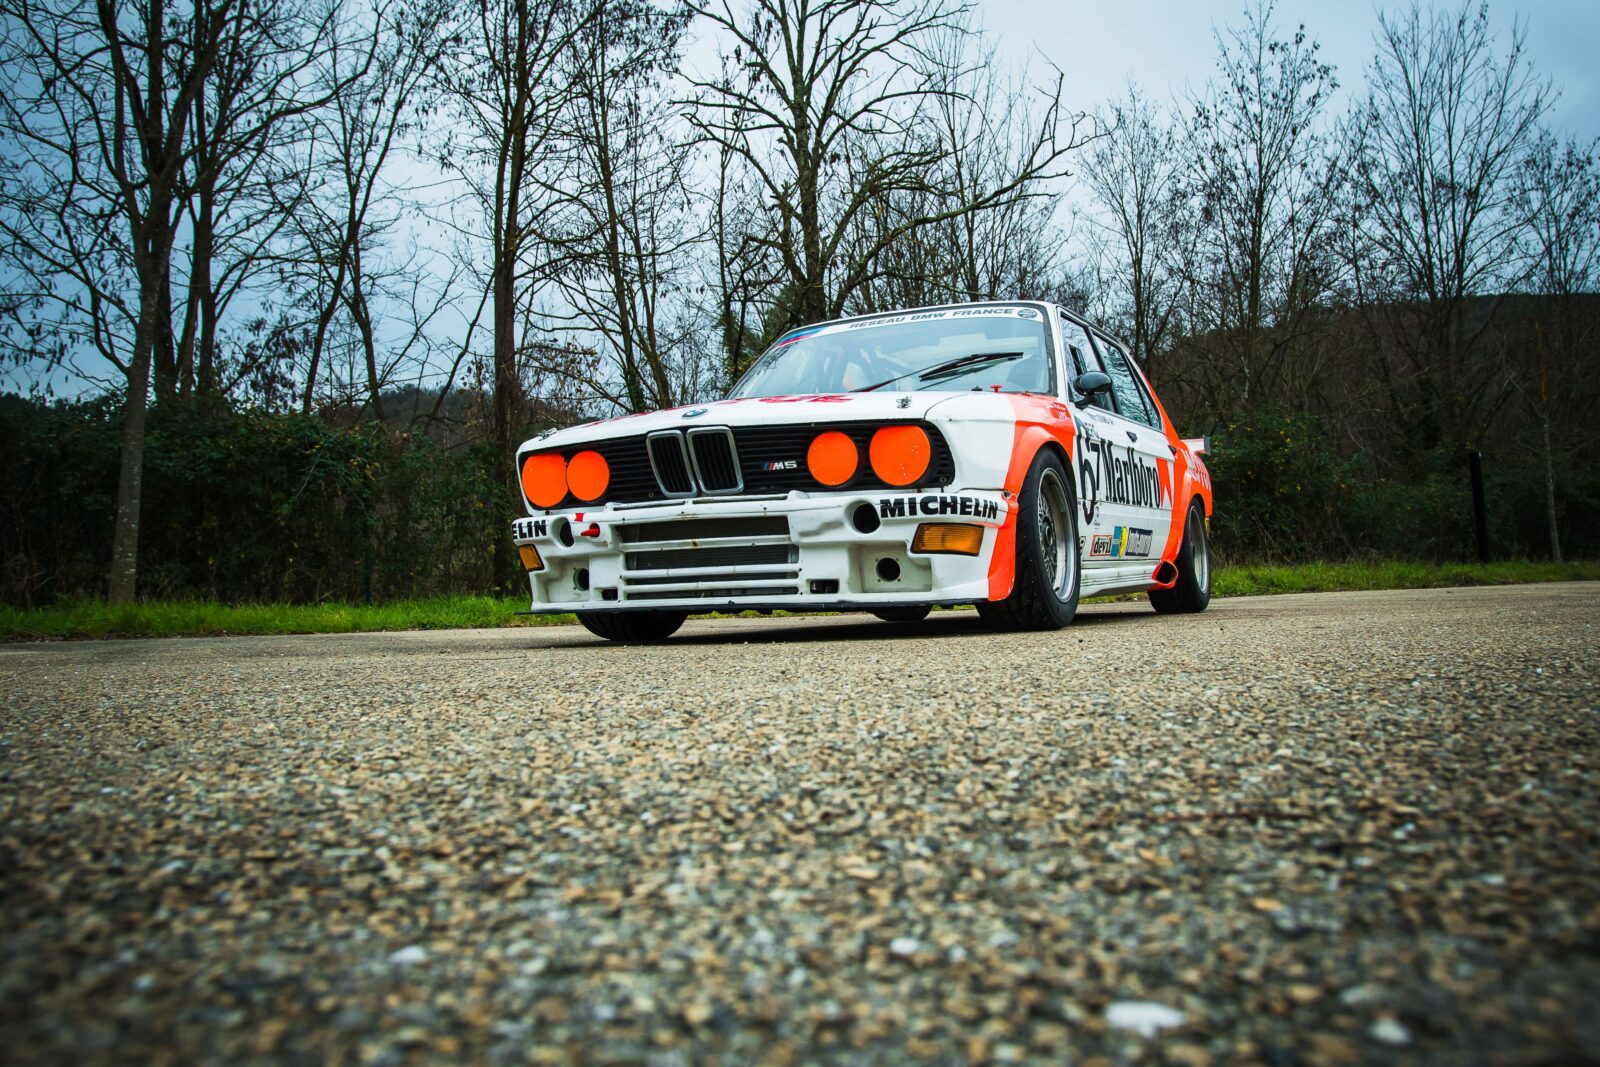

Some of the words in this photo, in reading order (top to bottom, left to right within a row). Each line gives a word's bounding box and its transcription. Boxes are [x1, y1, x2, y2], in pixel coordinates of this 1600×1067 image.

[849, 316, 906, 329] RESEAU
[911, 312, 947, 321] BMW
[953, 308, 1014, 317] FRANCE
[772, 460, 798, 470] M5
[1100, 438, 1161, 509] Marlboro
[880, 496, 998, 520] MICHELIN
[1093, 536, 1113, 554] devil
